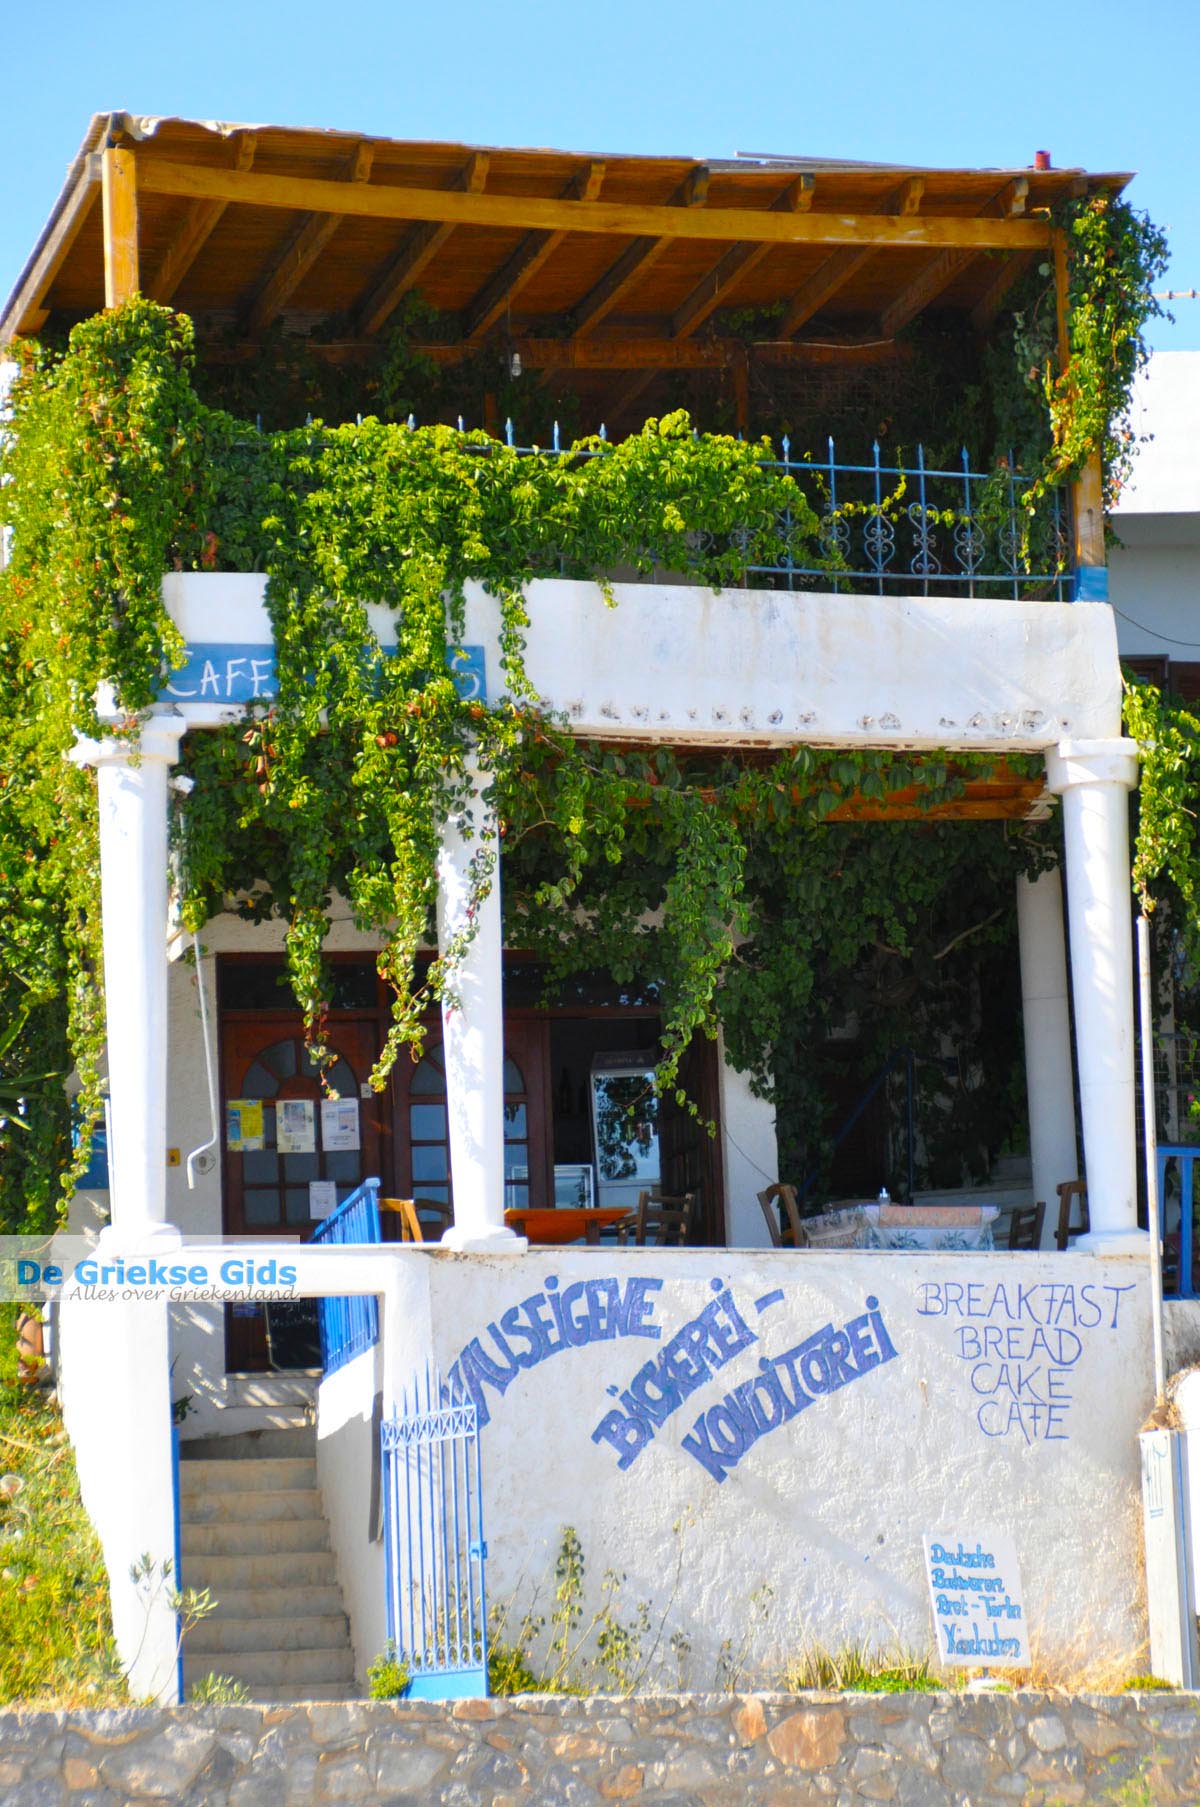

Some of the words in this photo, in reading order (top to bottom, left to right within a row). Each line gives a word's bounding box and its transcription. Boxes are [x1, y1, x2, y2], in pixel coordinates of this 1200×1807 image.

[916, 1283, 1136, 1329] BREAKFAST
[953, 1326, 1083, 1366] BREAD
[971, 1363, 1074, 1405] CAKE
[977, 1401, 1070, 1446] CAFE
[930, 1543, 995, 1568] Deutsche
